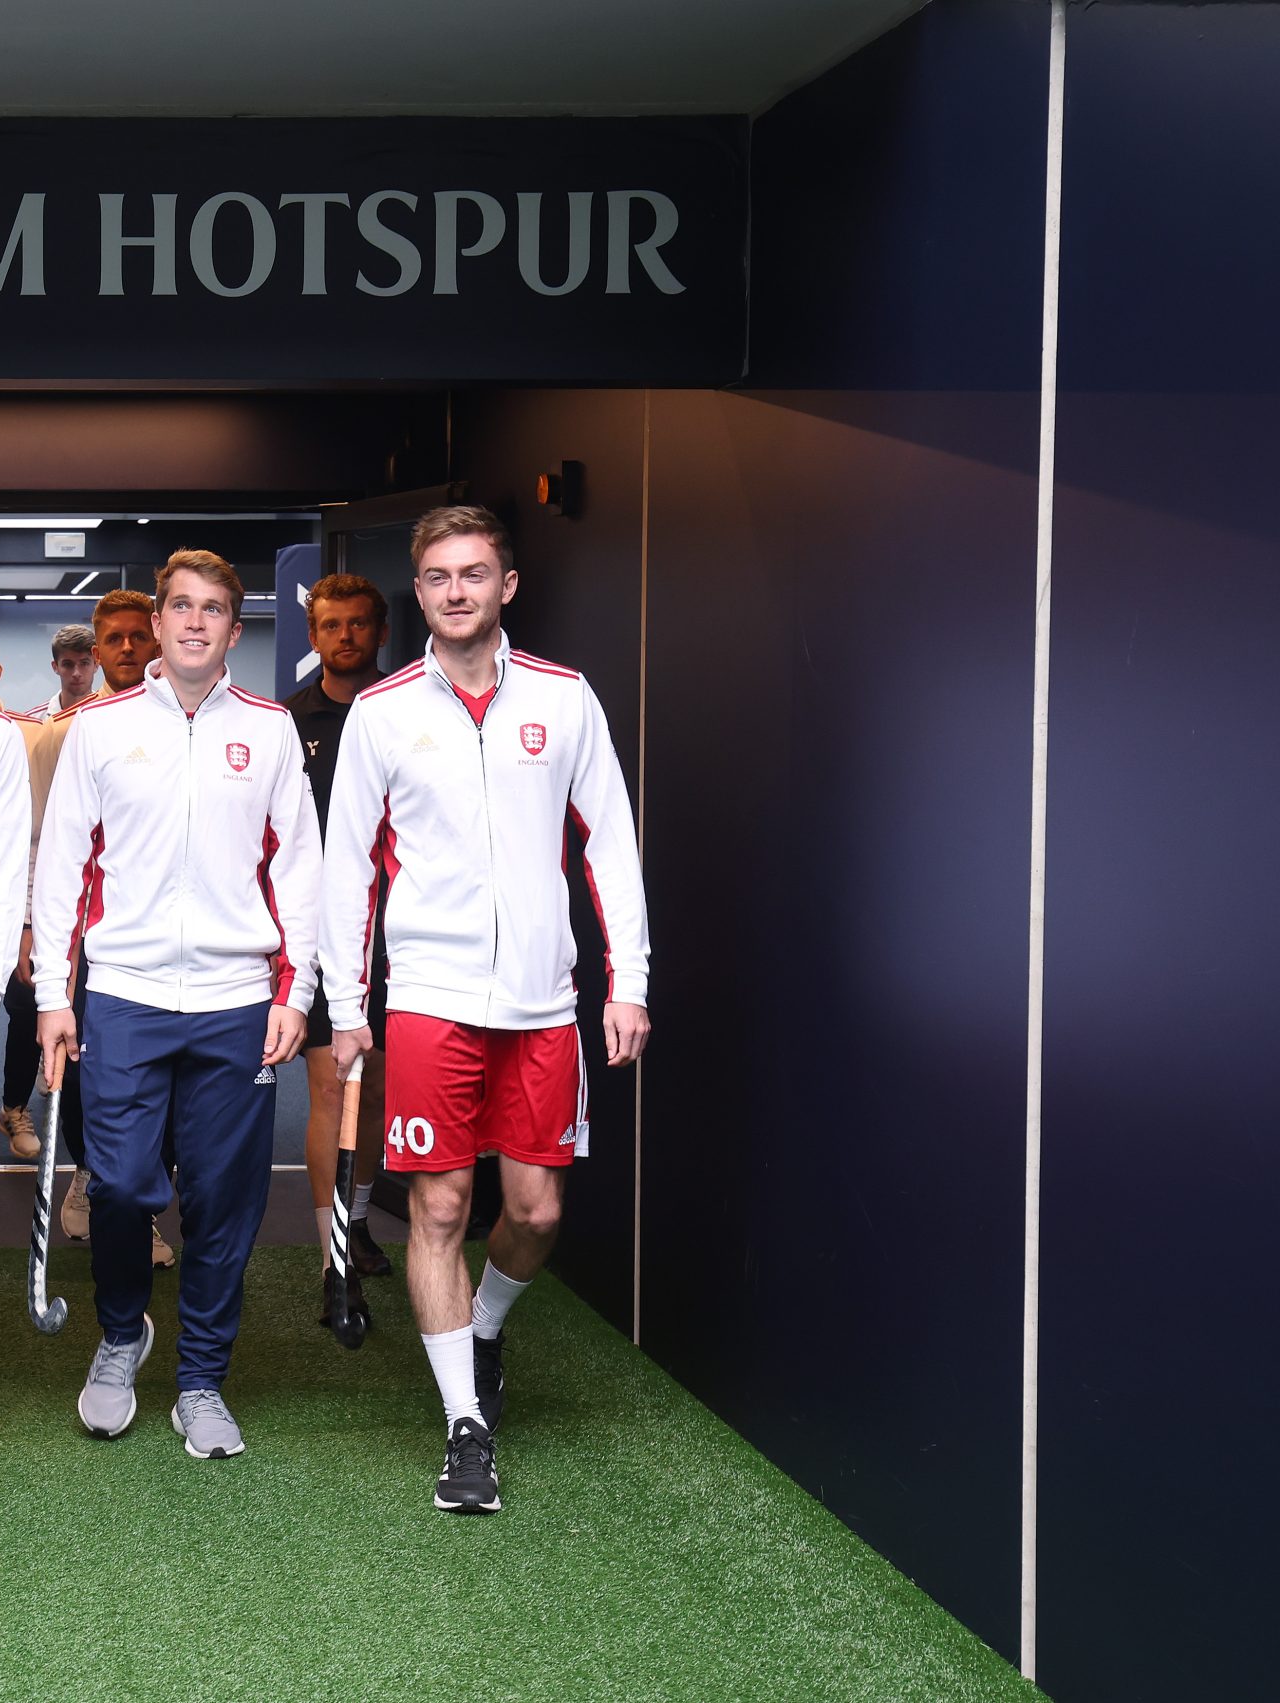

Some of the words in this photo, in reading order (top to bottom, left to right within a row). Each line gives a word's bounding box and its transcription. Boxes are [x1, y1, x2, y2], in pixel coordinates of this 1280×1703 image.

[97, 189, 688, 297] HOTSPUR
[518, 759, 549, 767] ENGLAND
[223, 773, 253, 783] ENGLAND
[254, 1076, 276, 1085] adida
[387, 1115, 435, 1156] 40
